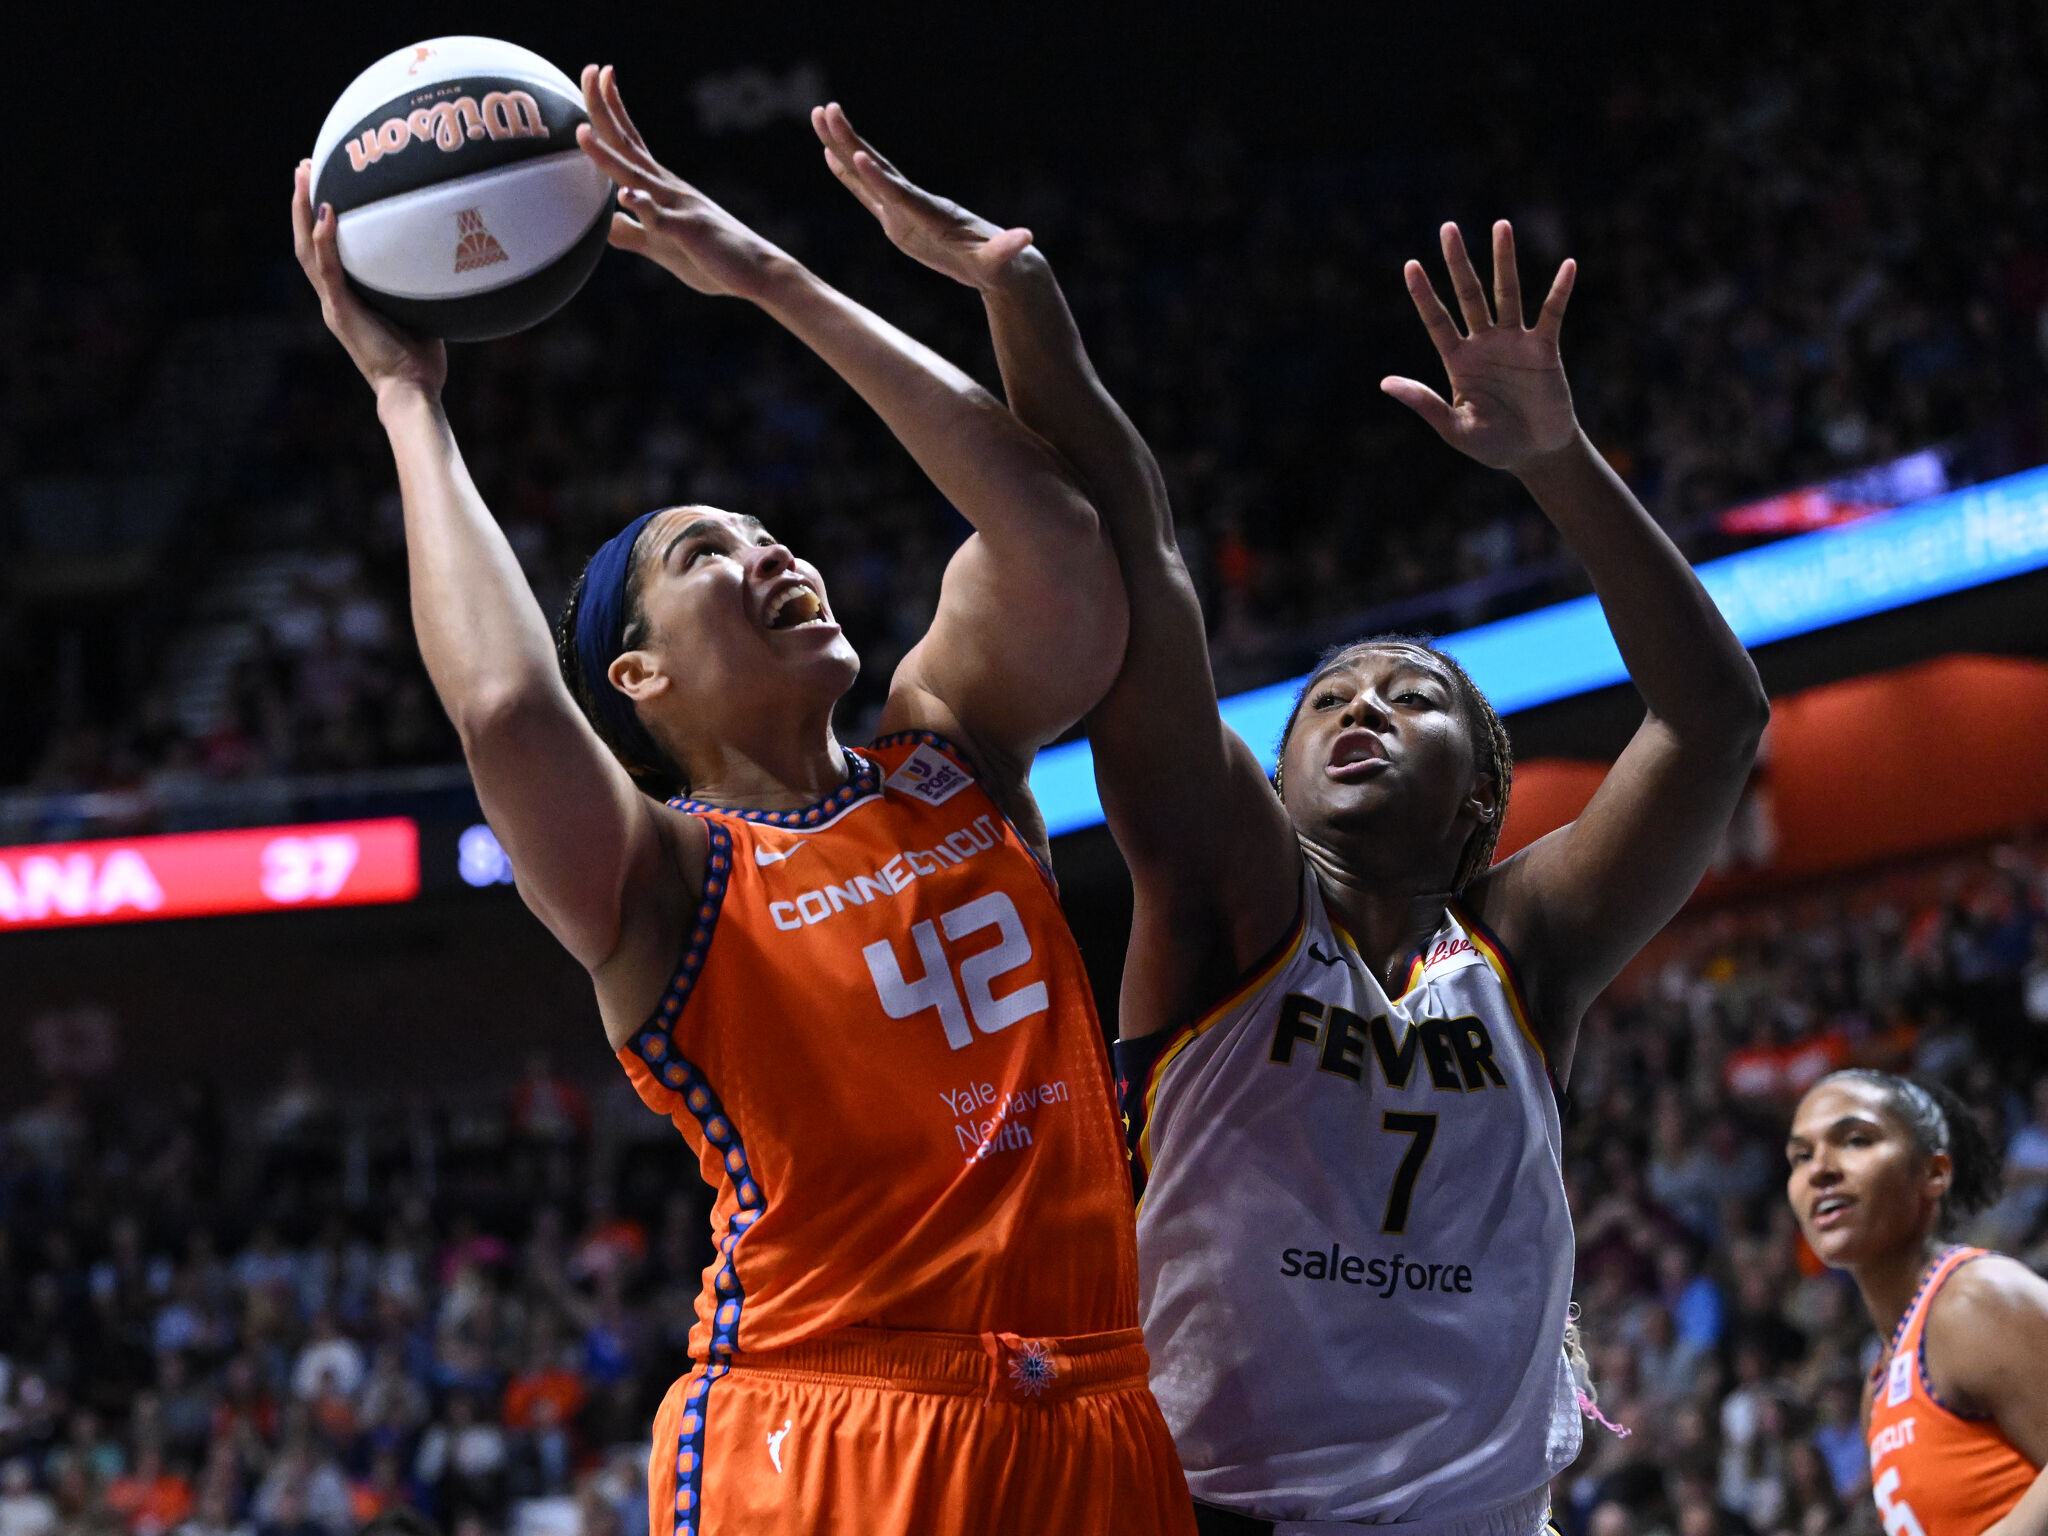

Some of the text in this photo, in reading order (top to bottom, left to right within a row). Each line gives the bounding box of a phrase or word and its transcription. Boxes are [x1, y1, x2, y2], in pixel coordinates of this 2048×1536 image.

[345, 90, 549, 172] Wilson
[917, 763, 964, 796] Post
[769, 814, 1003, 931] CONNECTICUT
[862, 891, 1050, 1051] 42
[1268, 993, 1508, 1092] FEVER
[940, 1081, 998, 1118] Yale
[1381, 1110, 1439, 1235] 7
[1280, 1243, 1473, 1299] salesforce
